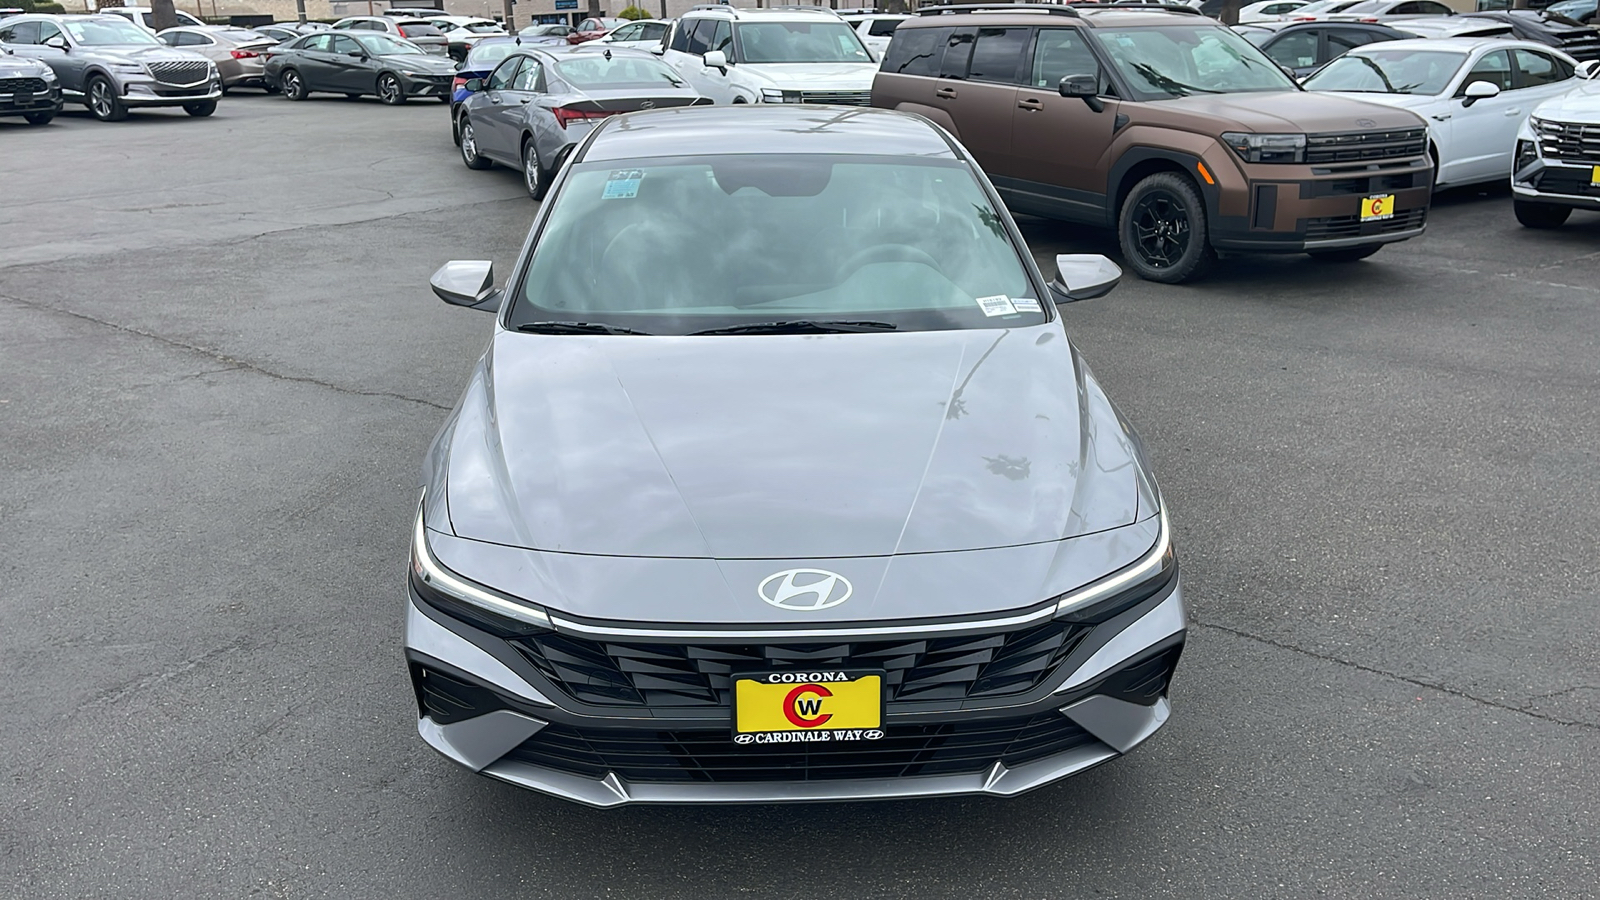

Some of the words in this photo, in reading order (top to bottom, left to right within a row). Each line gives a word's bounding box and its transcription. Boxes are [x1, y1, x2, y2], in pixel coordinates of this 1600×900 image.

[768, 671, 848, 683] CORONA
[755, 731, 831, 744] CARDINALE
[833, 729, 864, 741] WAY
